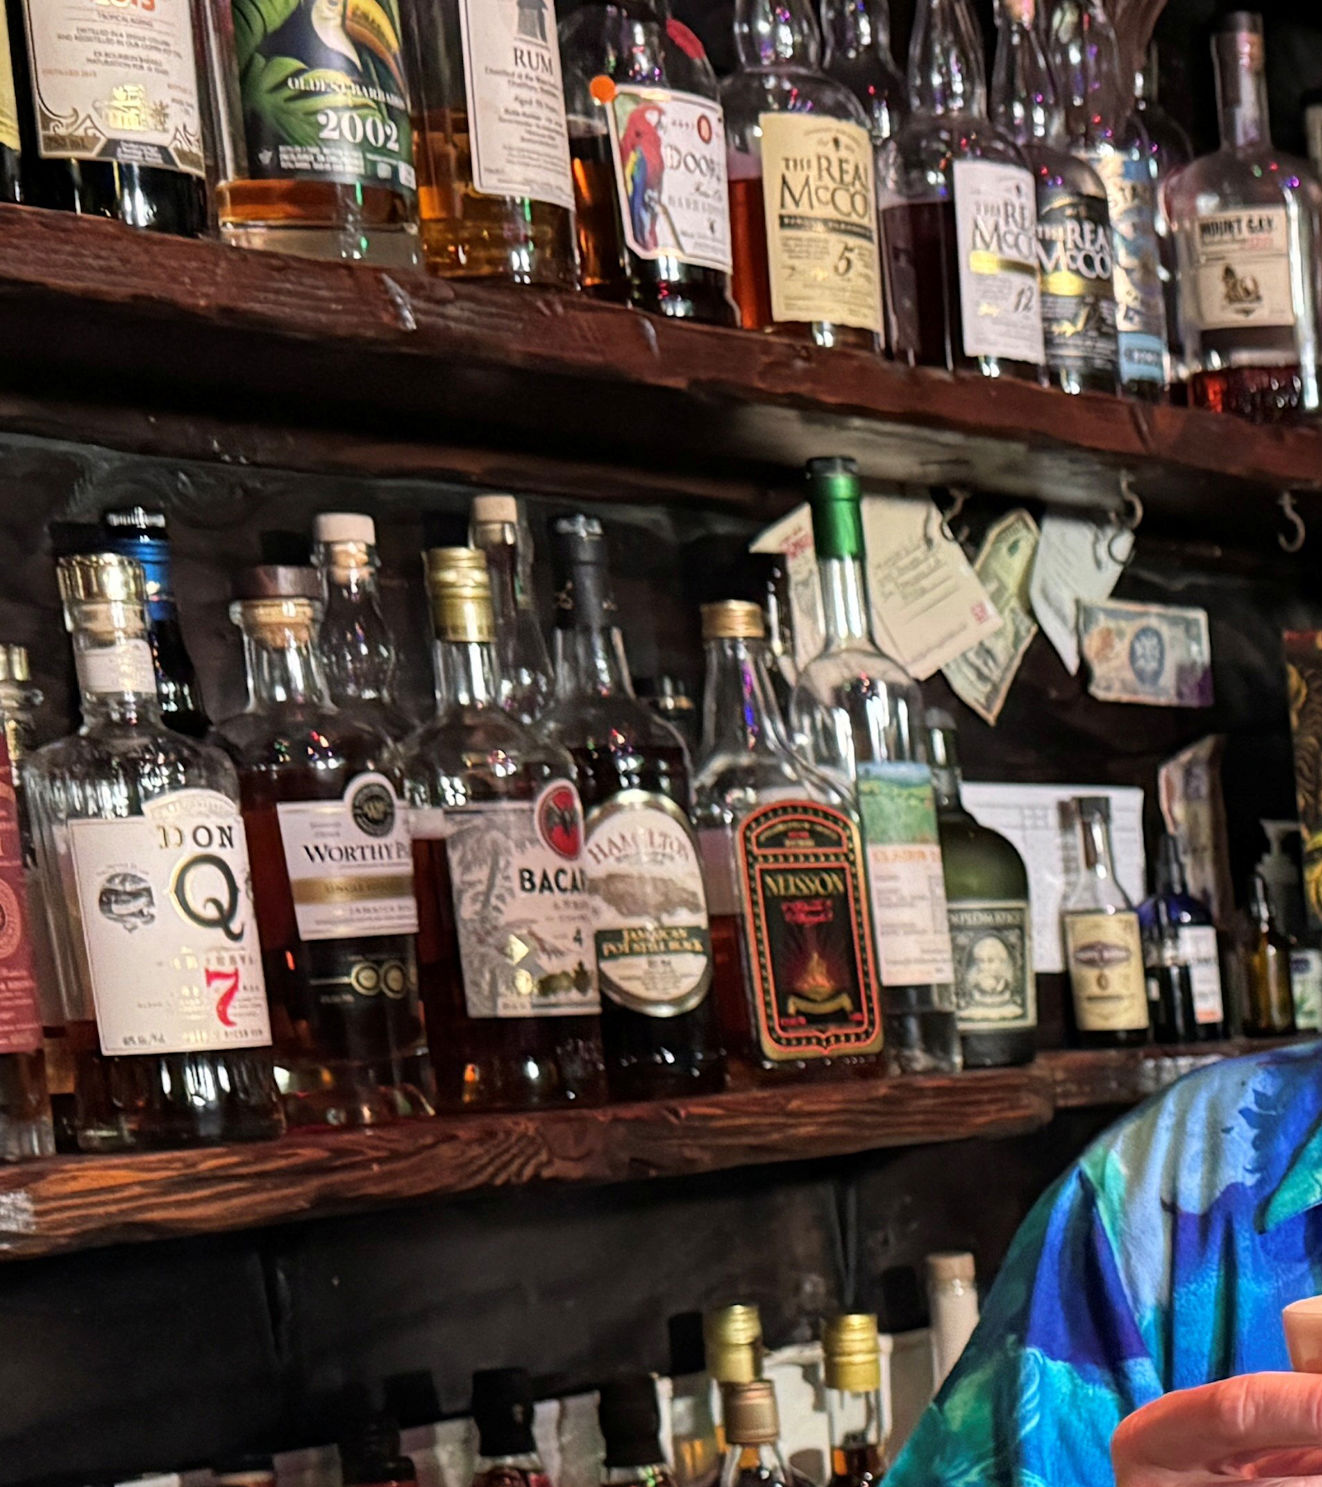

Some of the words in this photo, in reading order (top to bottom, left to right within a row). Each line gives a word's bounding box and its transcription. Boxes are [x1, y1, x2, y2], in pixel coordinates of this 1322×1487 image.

[513, 47, 554, 76] RUM
[317, 109, 400, 152] 2002
[780, 174, 870, 219] McCO
[1066, 219, 1111, 254] REA
[834, 242, 854, 277] 5
[1035, 239, 1112, 280] McCO
[159, 824, 235, 850] DON
[304, 843, 396, 863] WORTHY
[588, 830, 690, 865] HAMLTON
[169, 852, 246, 943] Q
[518, 866, 586, 895] BACA
[765, 871, 845, 898] NEISSON
[204, 966, 241, 1028] 7
